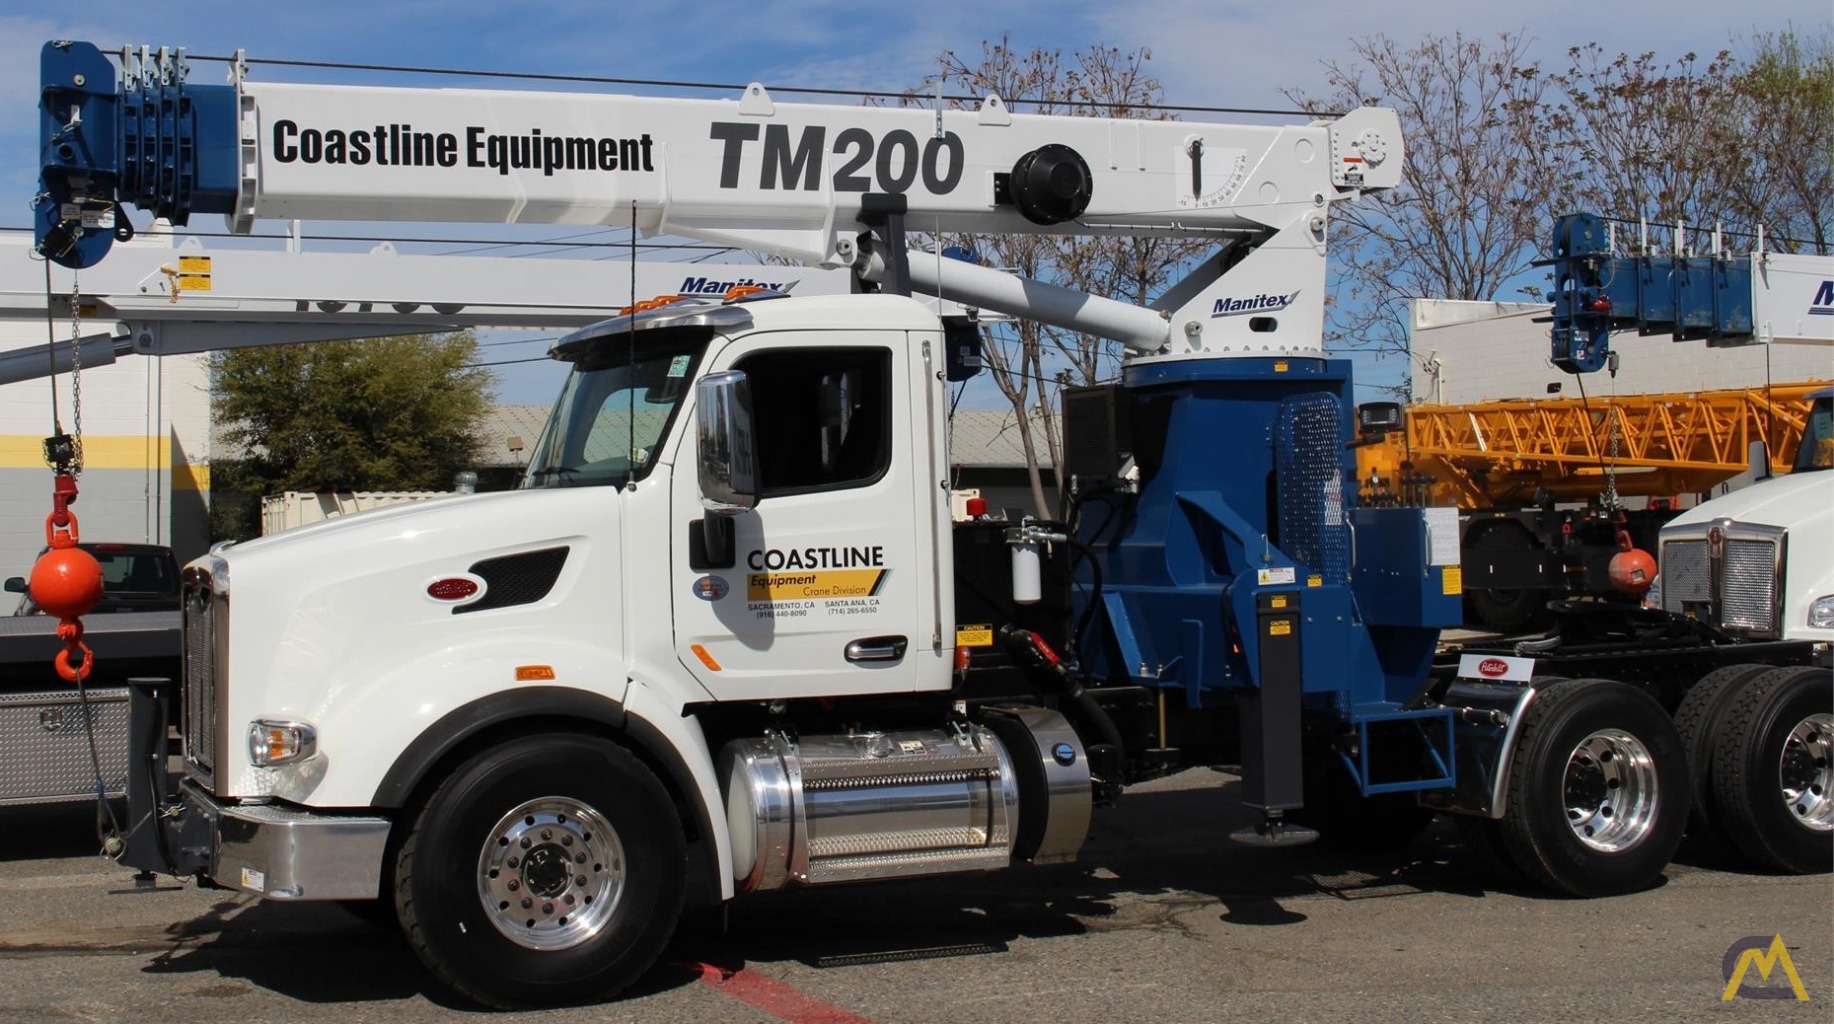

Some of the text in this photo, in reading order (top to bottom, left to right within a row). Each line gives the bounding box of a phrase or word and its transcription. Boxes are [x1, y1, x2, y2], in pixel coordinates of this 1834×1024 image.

[273, 119, 654, 176] Coastline Equipment
[709, 121, 965, 195] TM200
[1213, 294, 1289, 313] Manitex
[747, 546, 884, 571] COASTLINE
[751, 574, 817, 588] Equipment
[802, 585, 866, 597] Crane Division
[804, 601, 815, 609] CA
[828, 608, 846, 616] (714)
[756, 610, 774, 619] (916)
